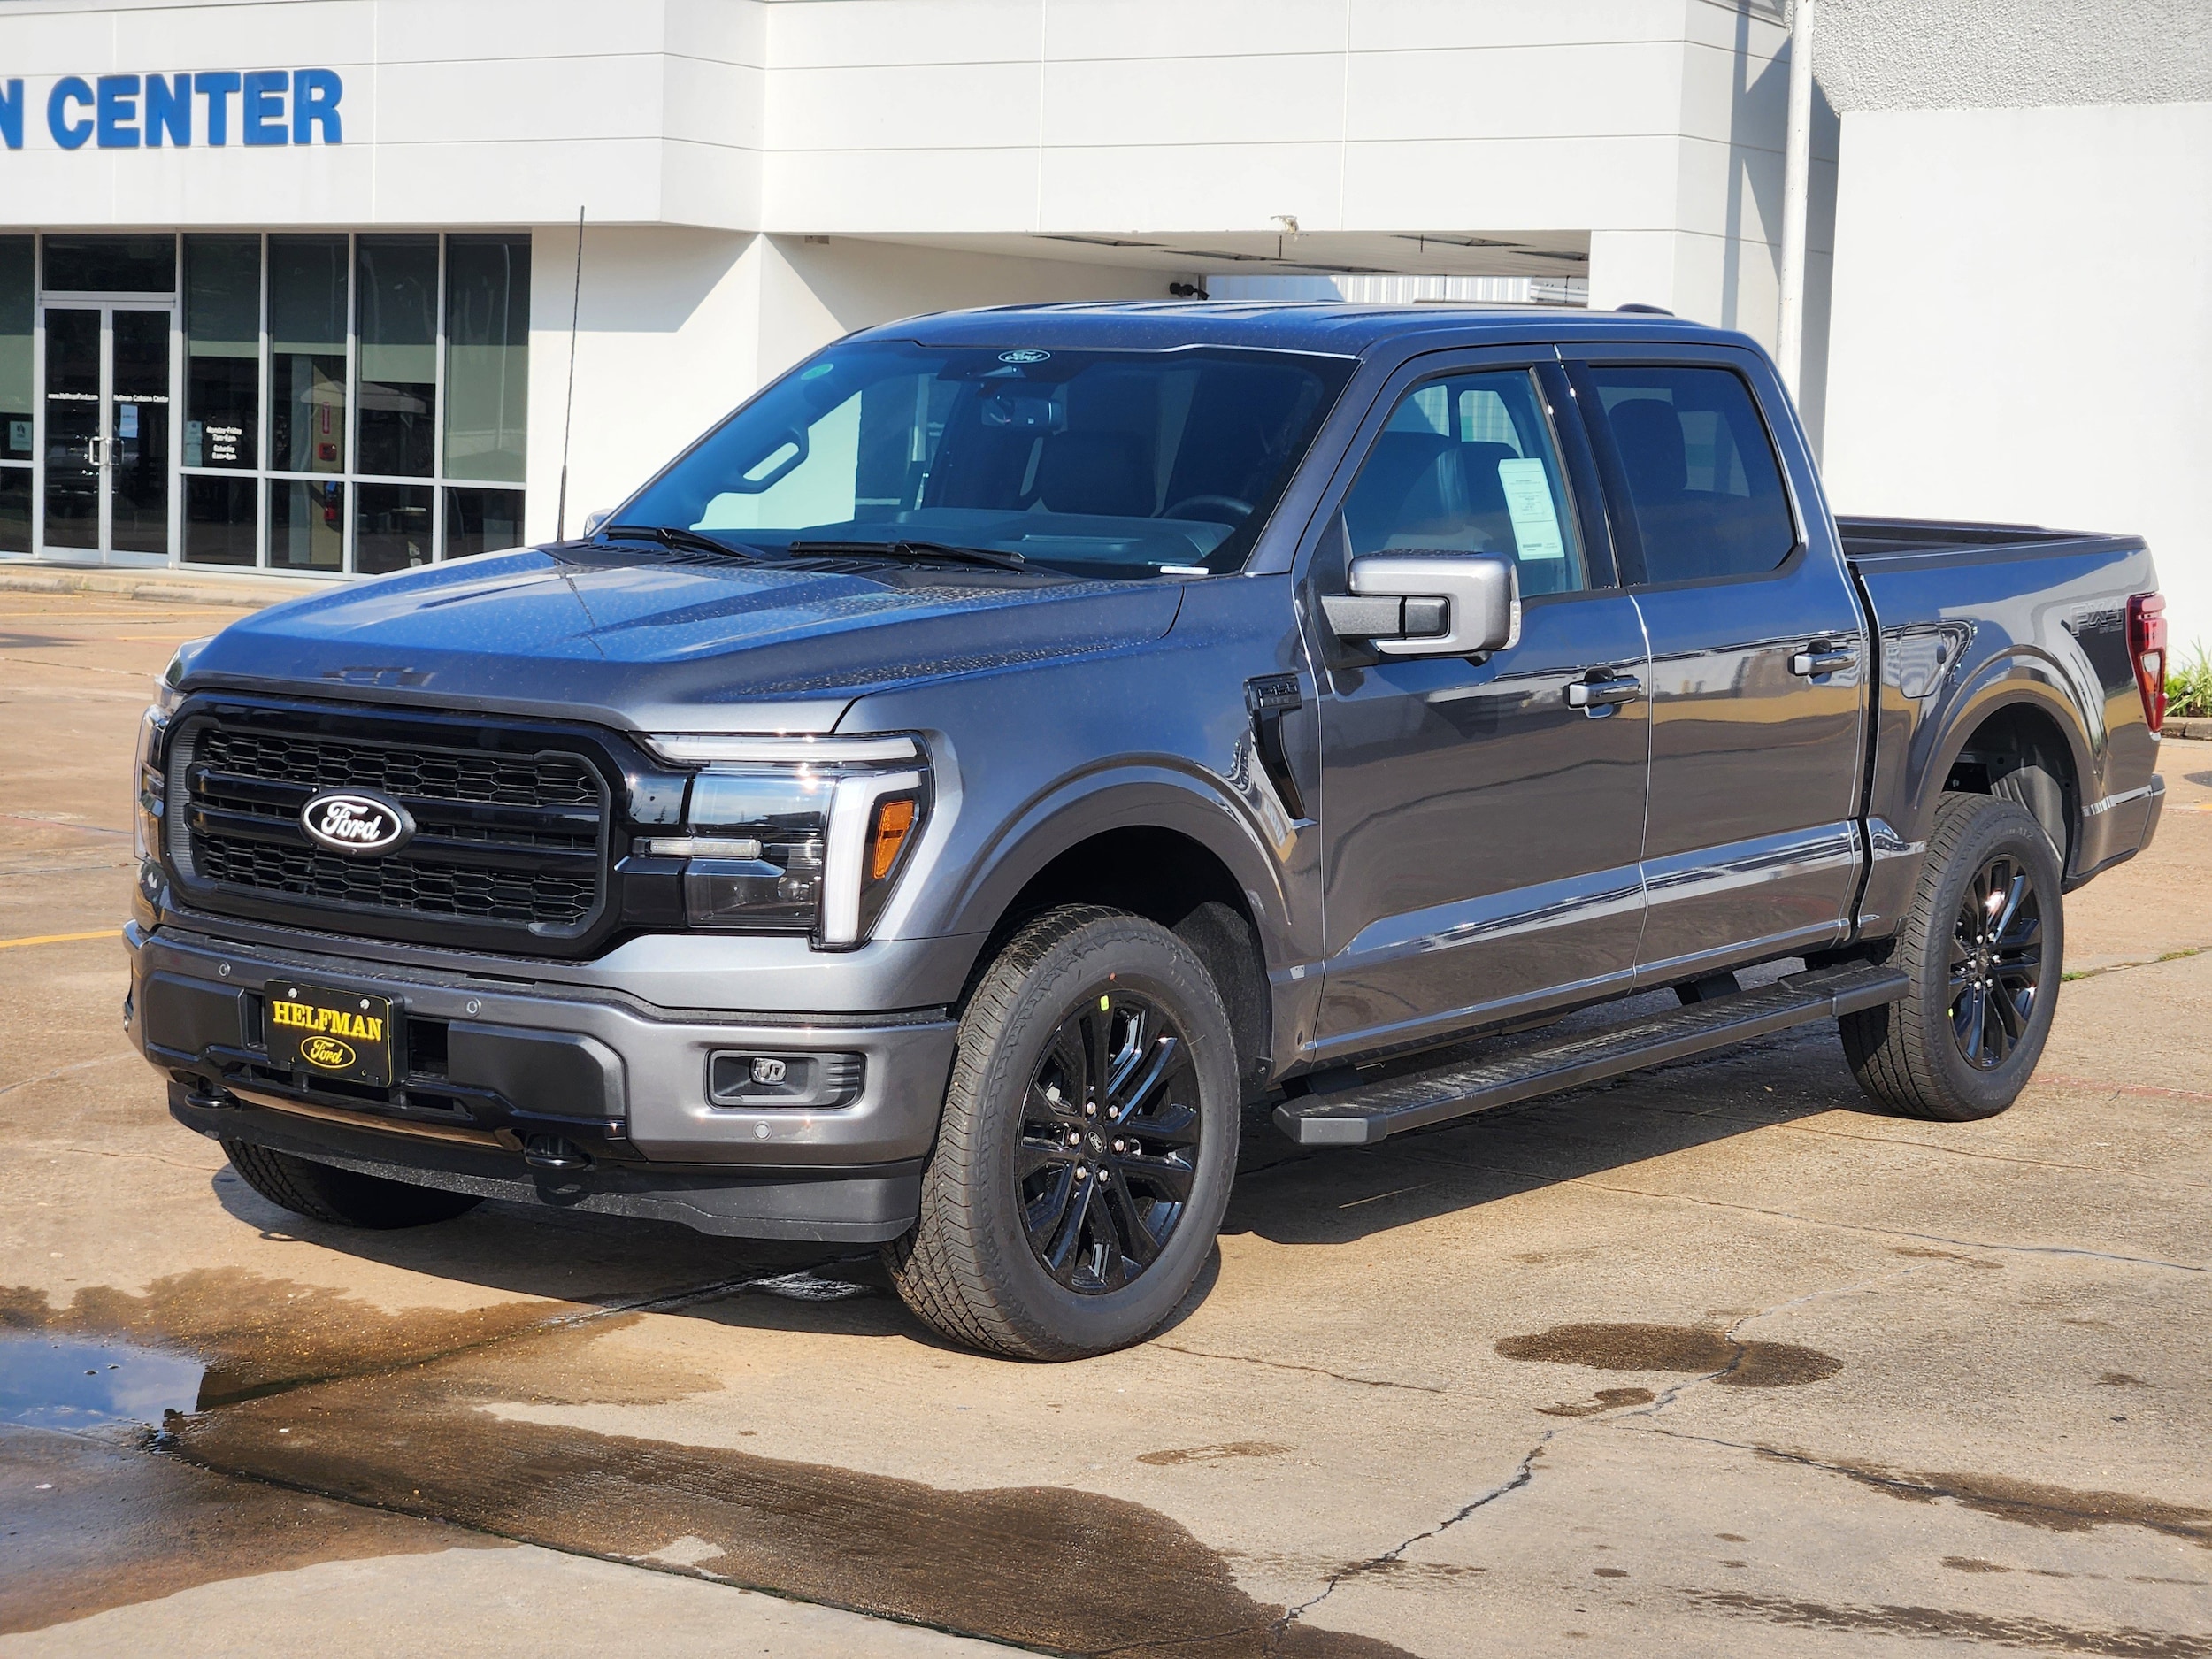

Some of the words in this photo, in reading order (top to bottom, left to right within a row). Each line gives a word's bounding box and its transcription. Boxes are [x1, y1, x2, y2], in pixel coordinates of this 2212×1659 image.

[47, 68, 343, 151] CENTER
[2070, 601, 2124, 638] FX4
[320, 801, 383, 841] Ford
[272, 1000, 383, 1042] HELFMAN
[310, 1039, 344, 1064] Ford
